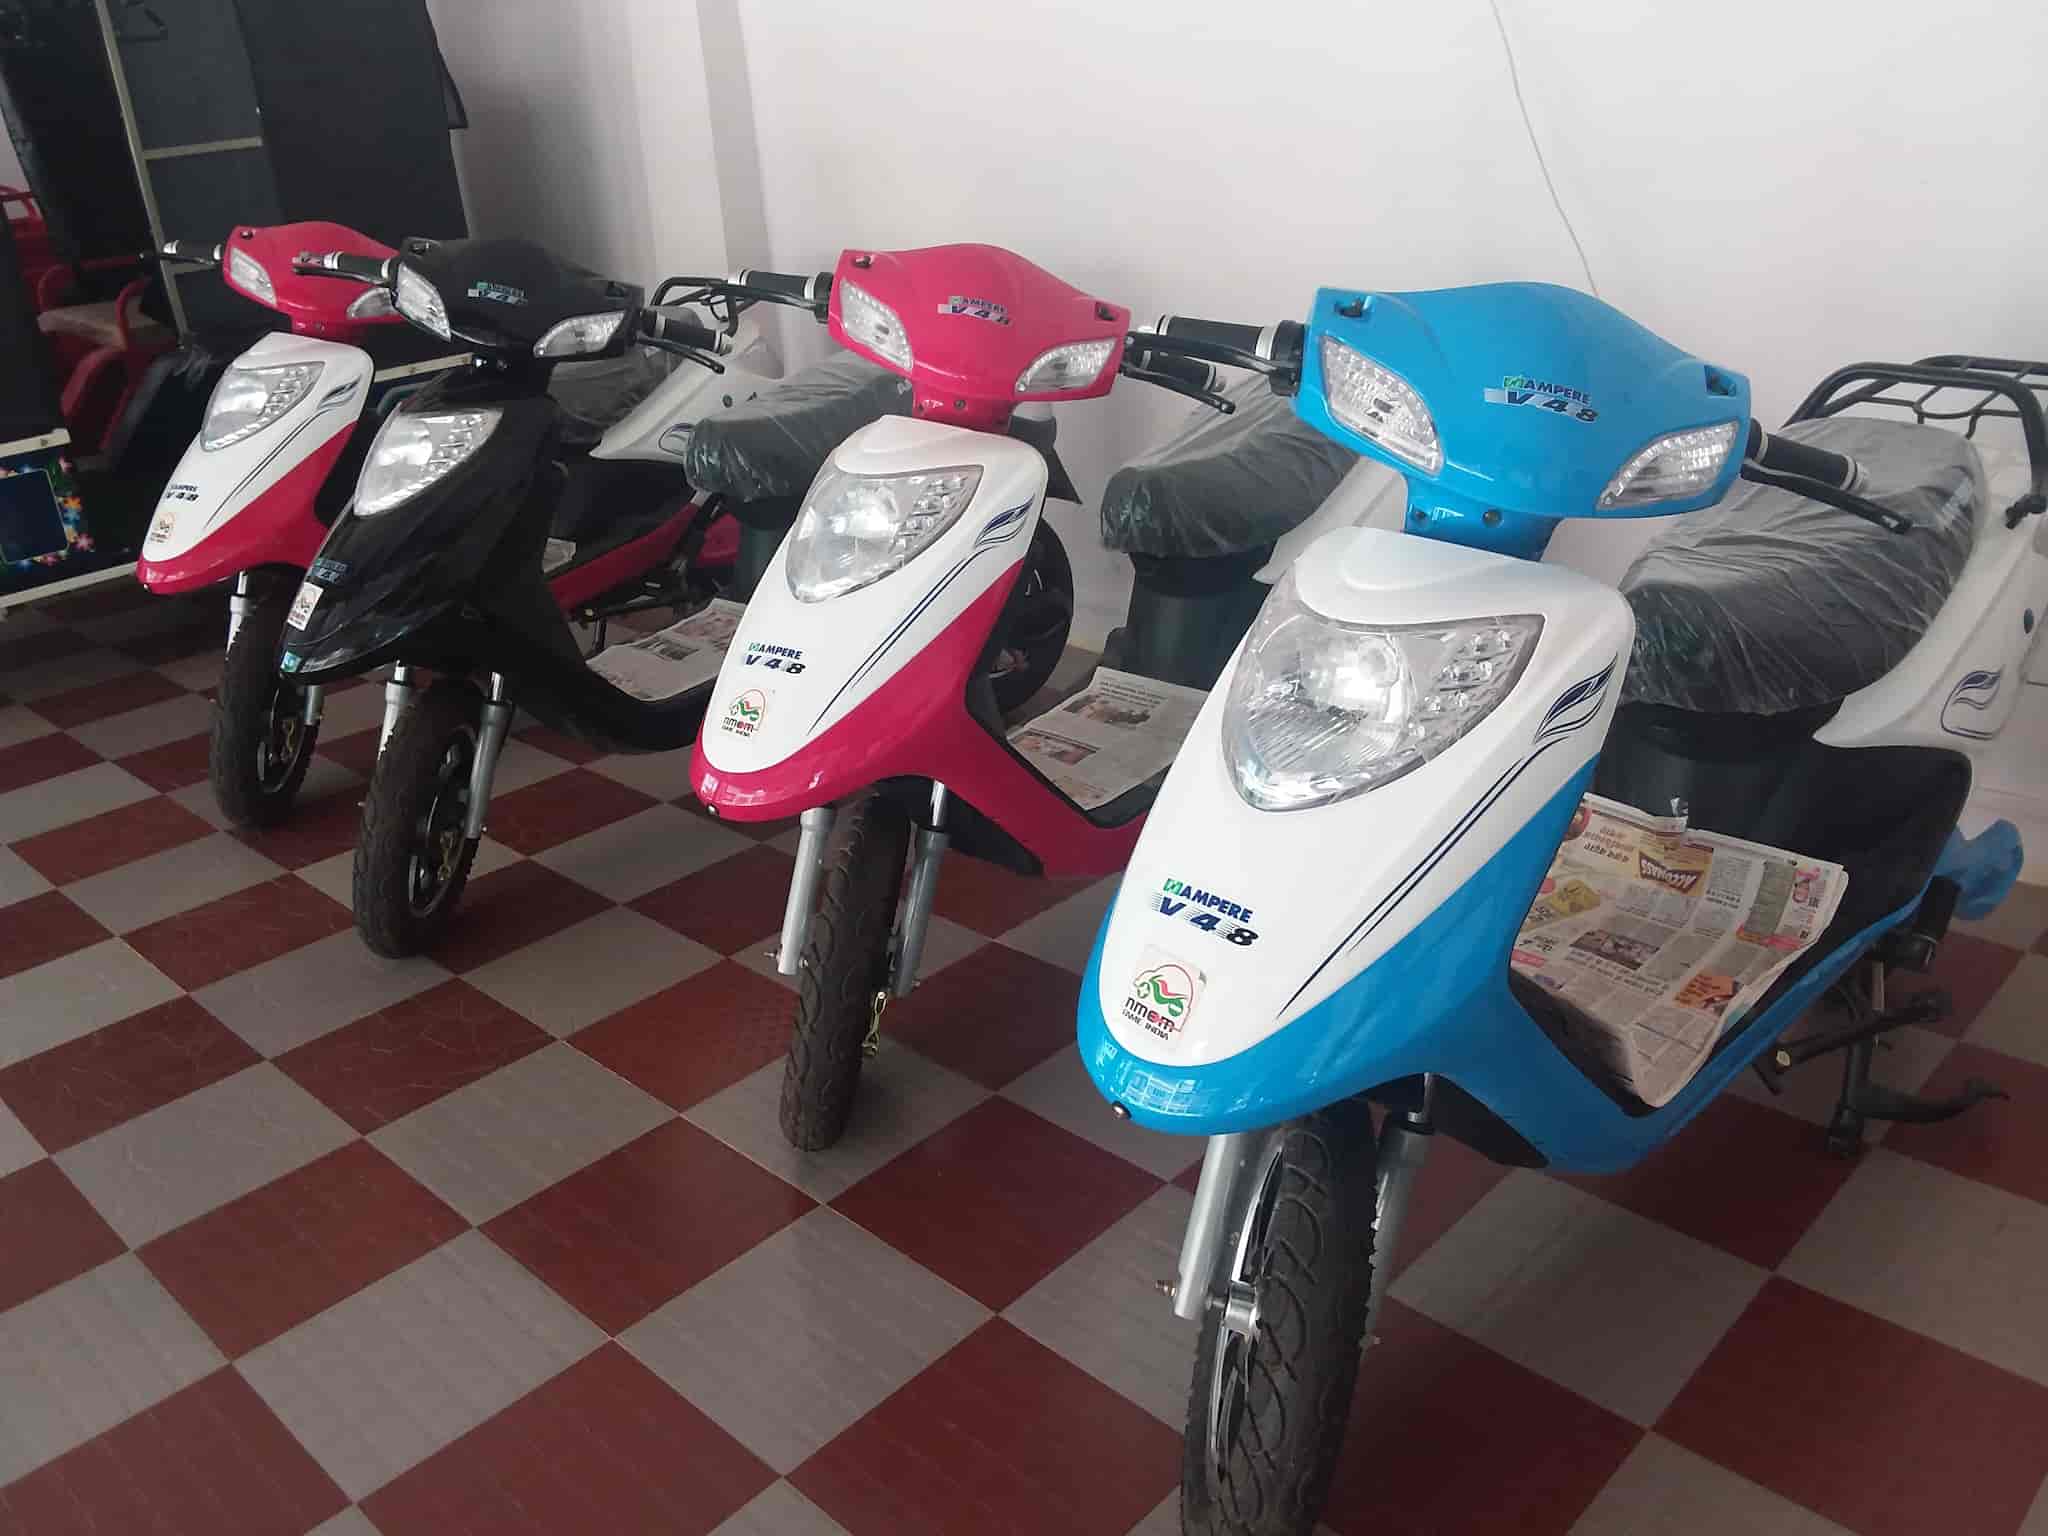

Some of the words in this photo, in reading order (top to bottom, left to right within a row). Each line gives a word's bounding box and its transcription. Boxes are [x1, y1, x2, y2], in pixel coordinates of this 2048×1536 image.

[1523, 379, 1592, 405] AMPERE
[758, 643, 803, 660] AMPERE
[1179, 885, 1253, 923] AMPERE
